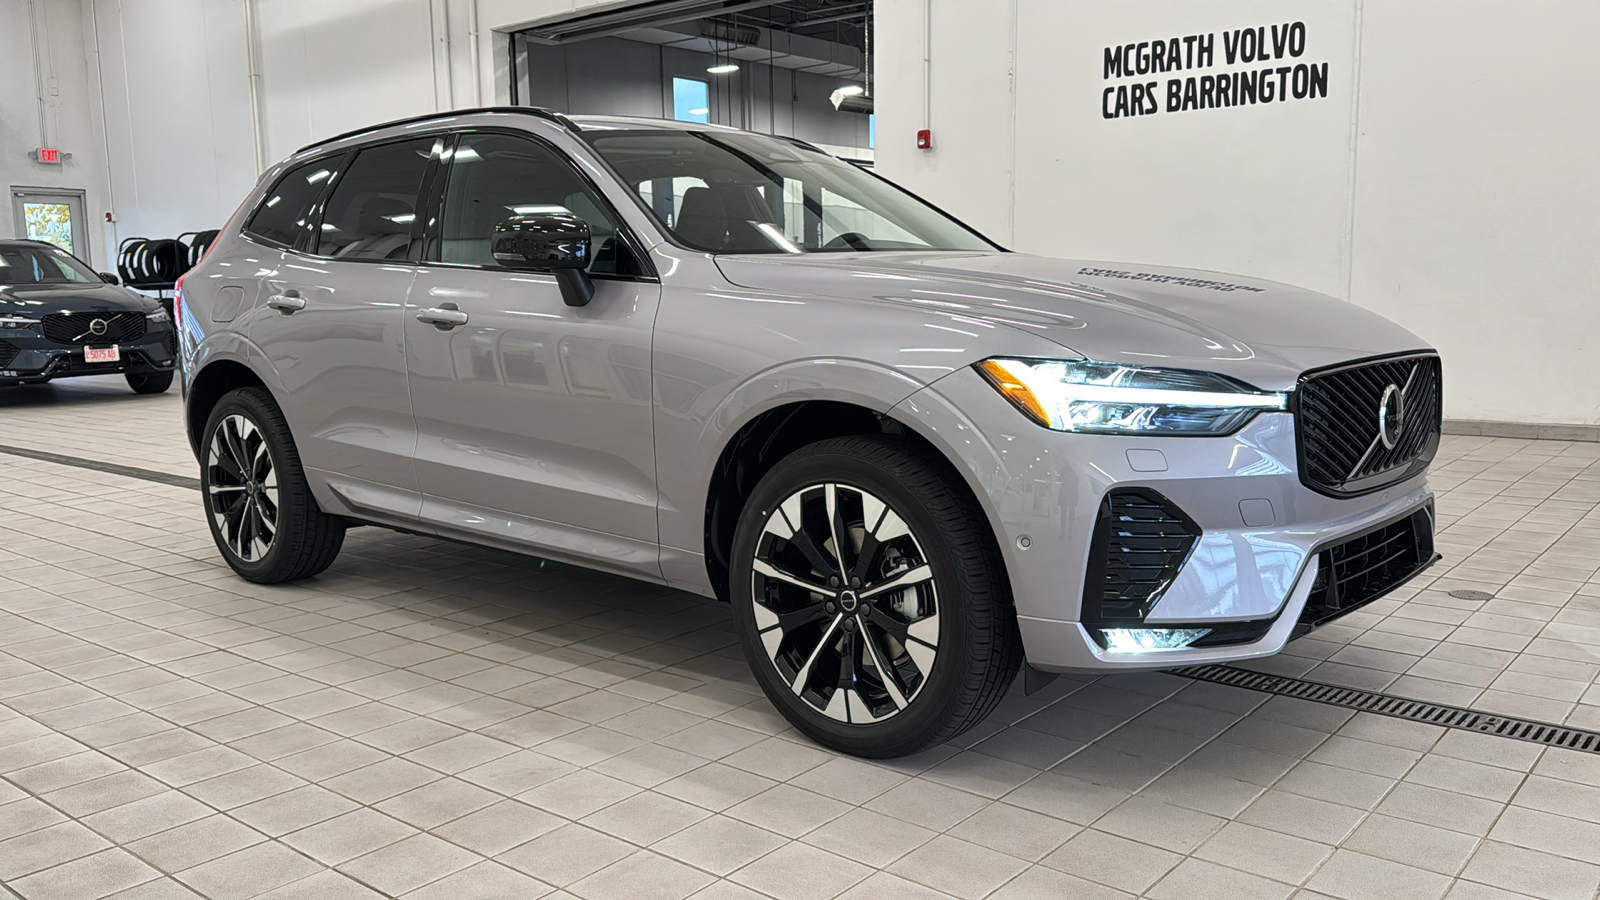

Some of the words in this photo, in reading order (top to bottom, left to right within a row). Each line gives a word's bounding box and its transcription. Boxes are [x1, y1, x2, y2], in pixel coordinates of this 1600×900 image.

[1103, 33, 1214, 79] MCGRATH
[1223, 21, 1306, 65] VOLVO
[1102, 81, 1158, 119] CARS
[1166, 62, 1328, 112] BARRINGTON
